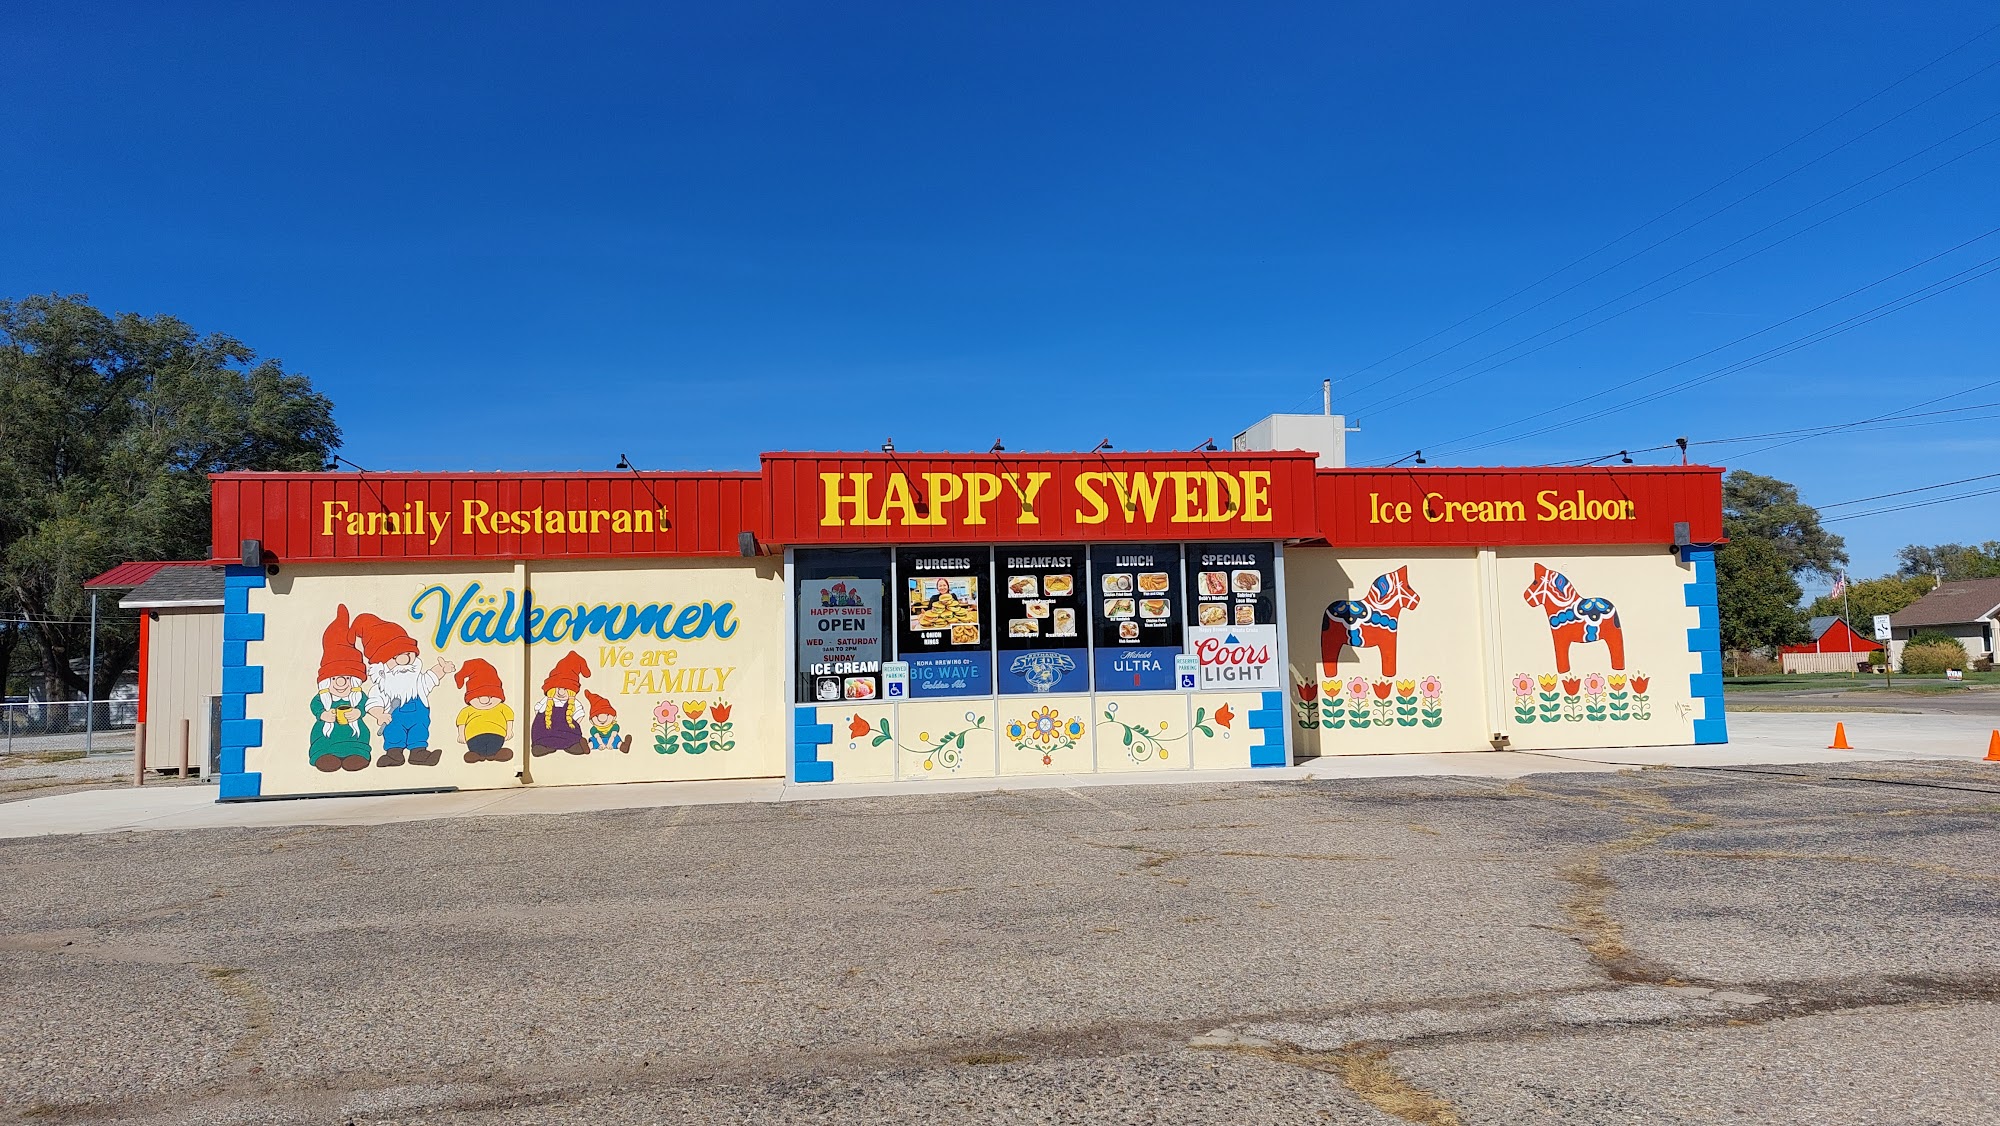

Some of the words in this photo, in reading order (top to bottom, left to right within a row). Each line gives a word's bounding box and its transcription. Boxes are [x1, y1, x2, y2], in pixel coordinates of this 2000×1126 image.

[820, 472, 1052, 527] HAPPY
[1075, 471, 1273, 525] SWEDE
[1370, 493, 1412, 524] Ice
[1422, 492, 1527, 523] Cream
[1536, 490, 1636, 521] Saloon
[322, 501, 451, 545] Family
[462, 499, 669, 535] Restaurant
[915, 558, 971, 570] BURGERS
[1007, 556, 1072, 568] BREAKFAST
[1116, 555, 1154, 566] LUNCH
[1202, 554, 1256, 566] SPECIALS
[411, 582, 739, 651] Välkommen
[810, 608, 840, 616] HAPPY
[841, 607, 872, 615] SWEDE
[818, 618, 866, 631] OPEN
[600, 646, 634, 668] We
[640, 649, 678, 667] are
[823, 654, 856, 662] SUNDAY
[1195, 638, 1270, 666] Coors
[810, 663, 831, 675] ICE
[835, 661, 879, 674] CREAM
[1012, 656, 1075, 669] SWEDES
[1114, 660, 1161, 671] ULTRA
[910, 667, 934, 679] BIG
[938, 666, 979, 678] WAVE
[1205, 666, 1263, 681] LIGHT
[620, 667, 736, 695] FAMILY
[922, 680, 950, 690] Golden
[951, 679, 967, 689] Ale
